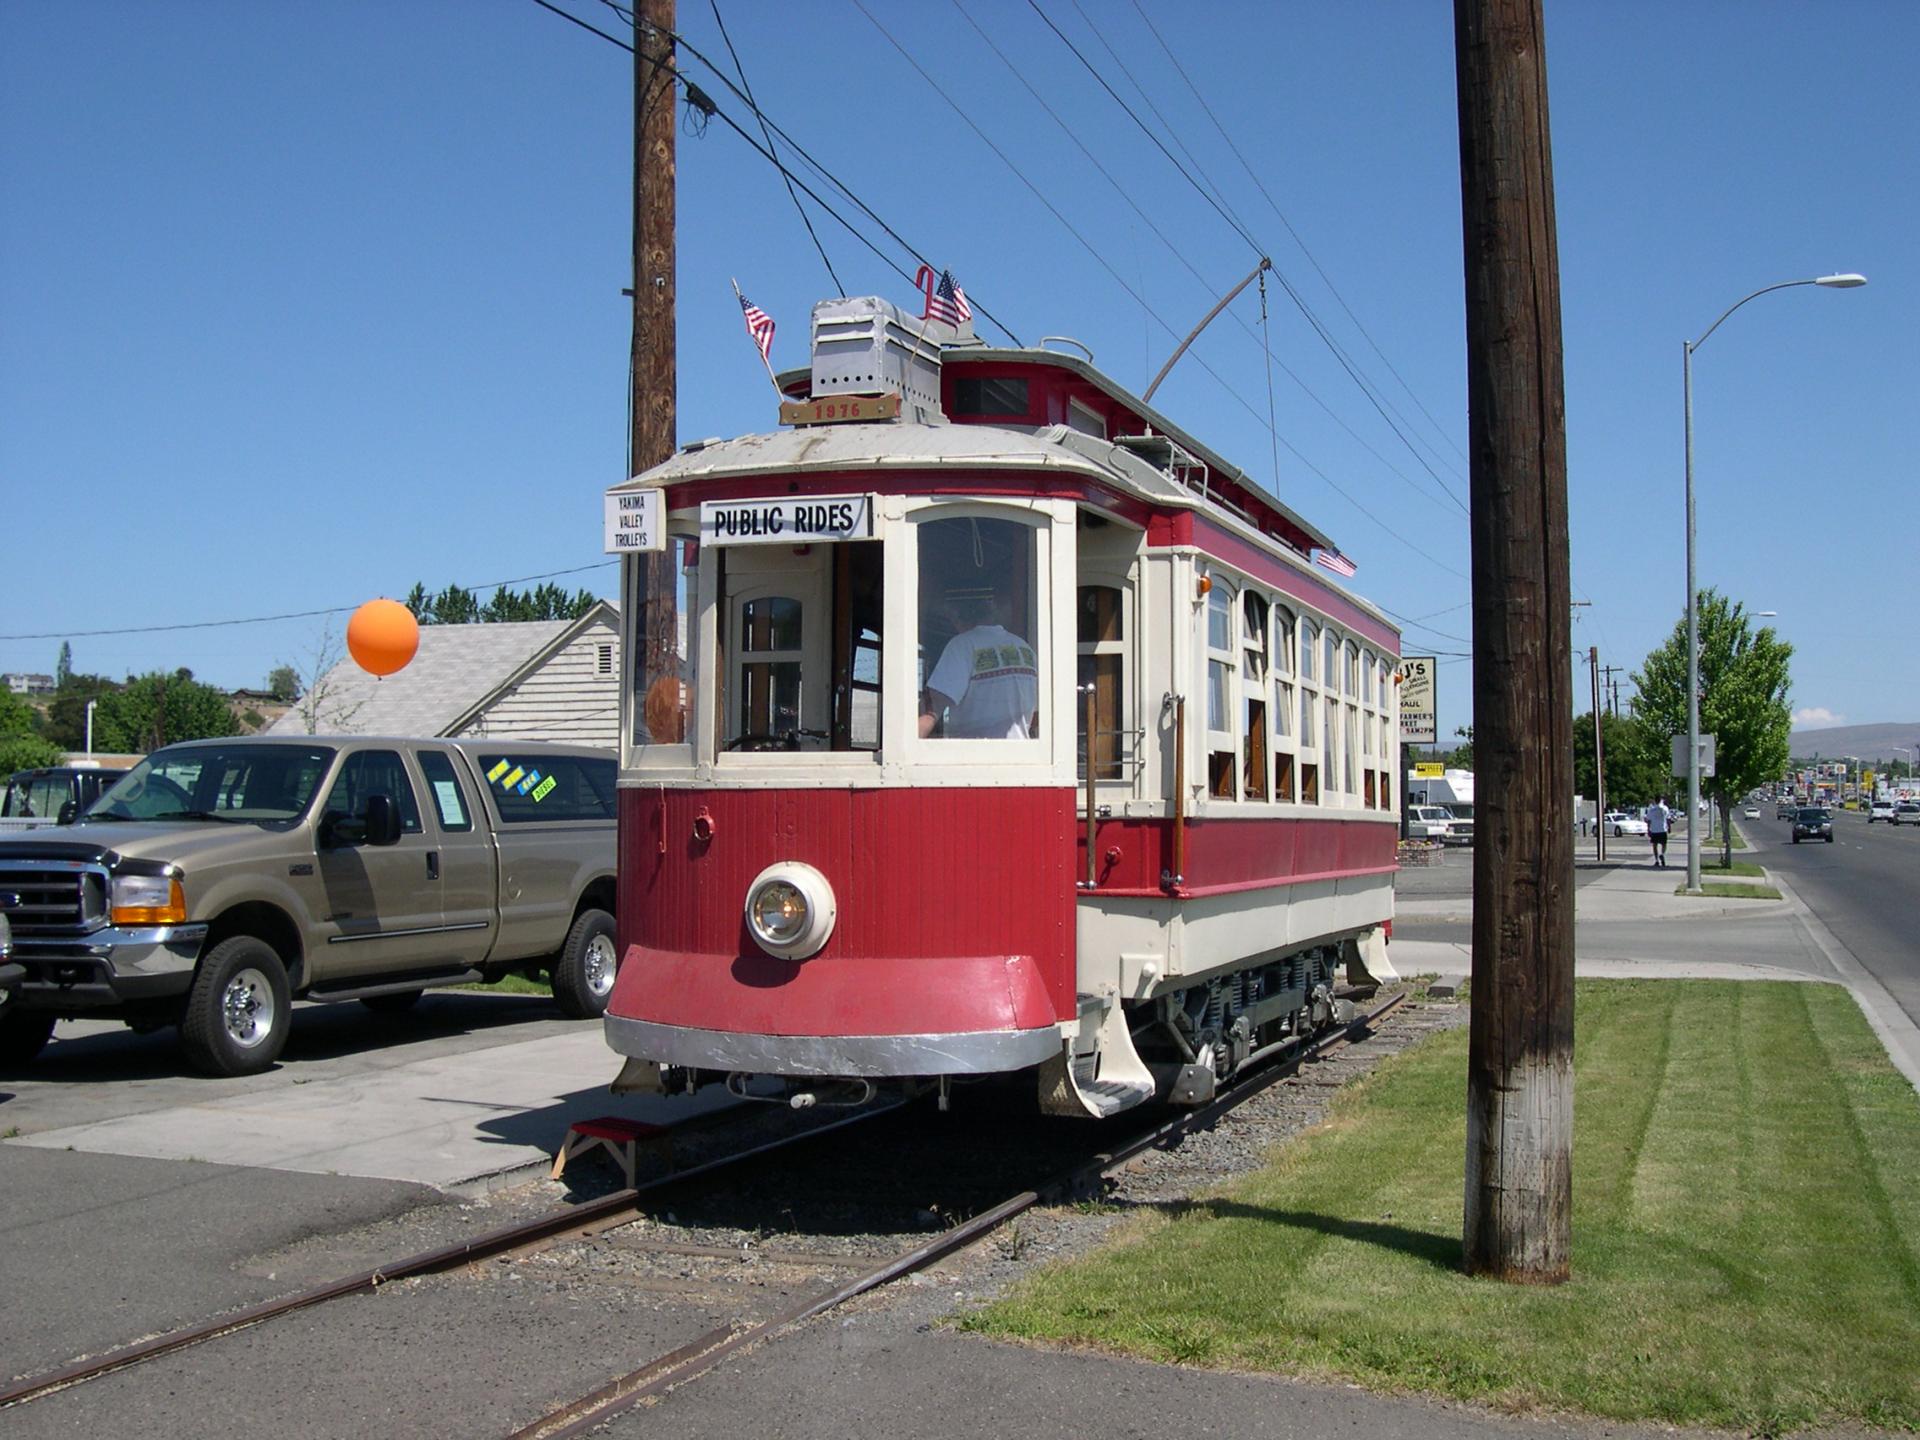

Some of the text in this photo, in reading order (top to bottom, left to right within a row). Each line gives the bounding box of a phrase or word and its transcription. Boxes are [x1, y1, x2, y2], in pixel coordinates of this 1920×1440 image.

[815, 402, 860, 419] 1976
[618, 495, 645, 510] YAKIMA
[619, 513, 644, 529] VALLEY
[714, 503, 854, 538] PUBLIC RIDES
[614, 531, 648, 547] TROLLEYS
[534, 778, 555, 800] DIESEL
